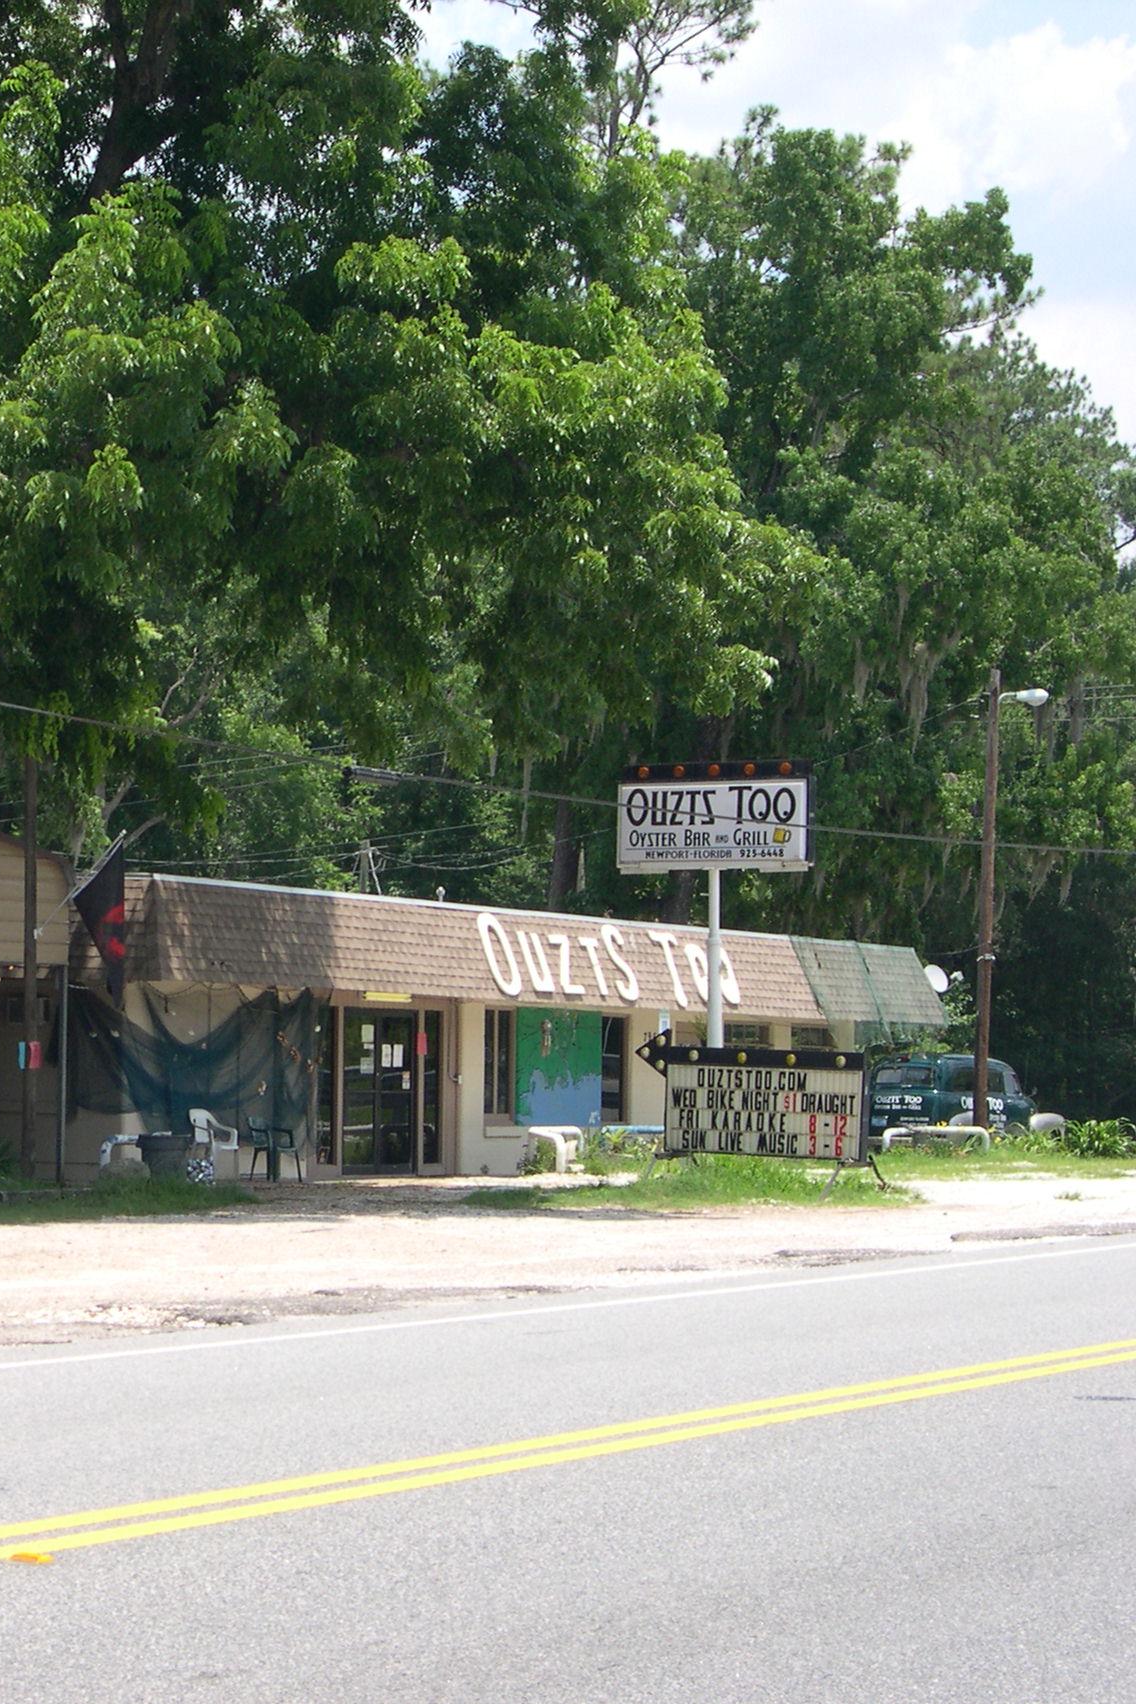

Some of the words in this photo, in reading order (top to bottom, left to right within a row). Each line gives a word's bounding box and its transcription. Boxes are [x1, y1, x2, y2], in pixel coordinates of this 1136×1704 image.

[626, 788, 715, 826] OUZTS
[729, 786, 796, 824] TOO
[629, 830, 676, 847] OYSTER
[684, 829, 710, 846] BAR
[733, 828, 768, 846] GRILL
[740, 848, 784, 858] 925-6448
[698, 1068, 807, 1091] OUZTSTOO.COM
[672, 1088, 697, 1108] WED
[707, 1090, 735, 1110] BIKE
[742, 1091, 779, 1112] NIGHT
[784, 1093, 796, 1112] $1
[802, 1094, 856, 1114] DRAUGHT
[679, 1109, 700, 1129] FRI
[711, 1112, 786, 1132] KARAOKE
[808, 1115, 817, 1134] 8
[834, 1116, 848, 1136] 12
[682, 1130, 706, 1150] SUN
[718, 1132, 743, 1151] LIVE
[757, 1133, 798, 1154] MUSIC
[808, 1136, 817, 1156] 3
[835, 1136, 843, 1156] 6
